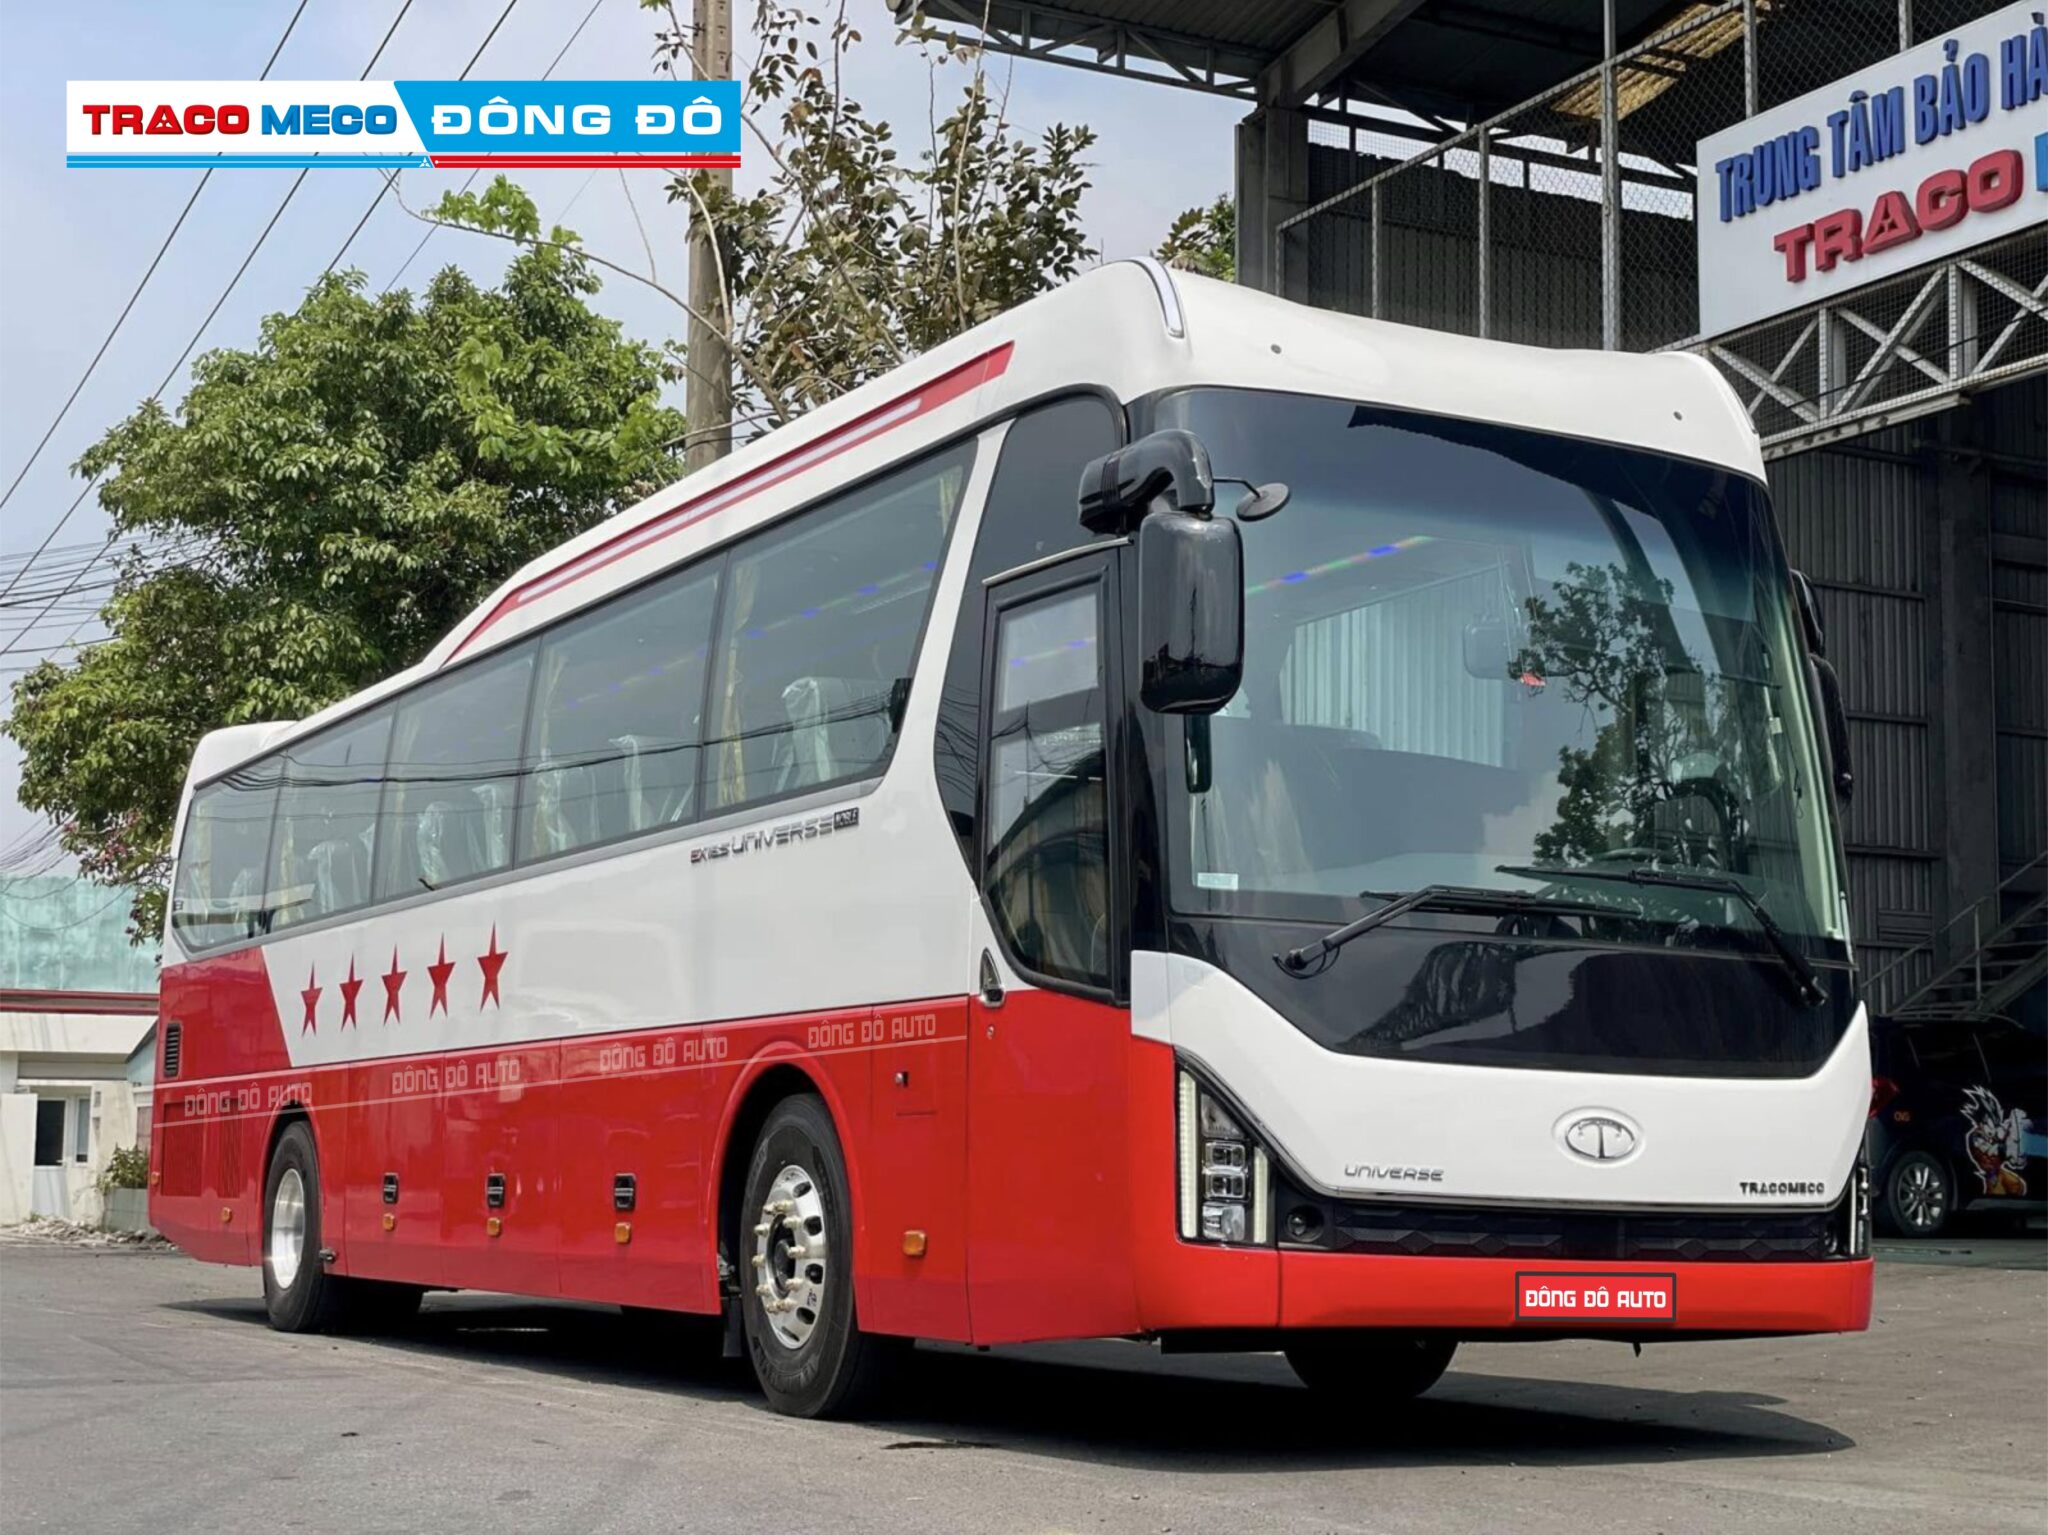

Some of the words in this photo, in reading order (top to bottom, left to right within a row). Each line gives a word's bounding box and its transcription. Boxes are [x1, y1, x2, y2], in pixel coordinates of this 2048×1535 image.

[1715, 125, 1821, 223] TRUNG
[1827, 86, 1906, 178] TÂM
[1914, 38, 1990, 146] BẢO
[1774, 149, 2024, 283] TRACO
[732, 816, 833, 854] UNIVERSE
[808, 1020, 854, 1048] ĐÔNG
[861, 1014, 884, 1042] ĐÔ
[892, 1014, 936, 1039] AUTO
[599, 1043, 646, 1072] ĐÔNG
[653, 1037, 676, 1065] ĐÔ
[683, 1036, 728, 1062] AUTO
[392, 1062, 437, 1094] ĐÔNG
[445, 1059, 468, 1088] ĐÔ
[476, 1059, 520, 1084] AUTO
[184, 1088, 231, 1117] ĐÔNG
[238, 1082, 261, 1111] ĐÔ
[268, 1082, 312, 1107] AUTO
[1344, 1164, 1445, 1183] UNIVERSE
[1739, 1181, 1825, 1195] TRACOMECO
[1525, 1285, 1577, 1308] ĐÔNG
[1583, 1286, 1610, 1308] ĐÔ
[1617, 1290, 1667, 1309] AUTO
